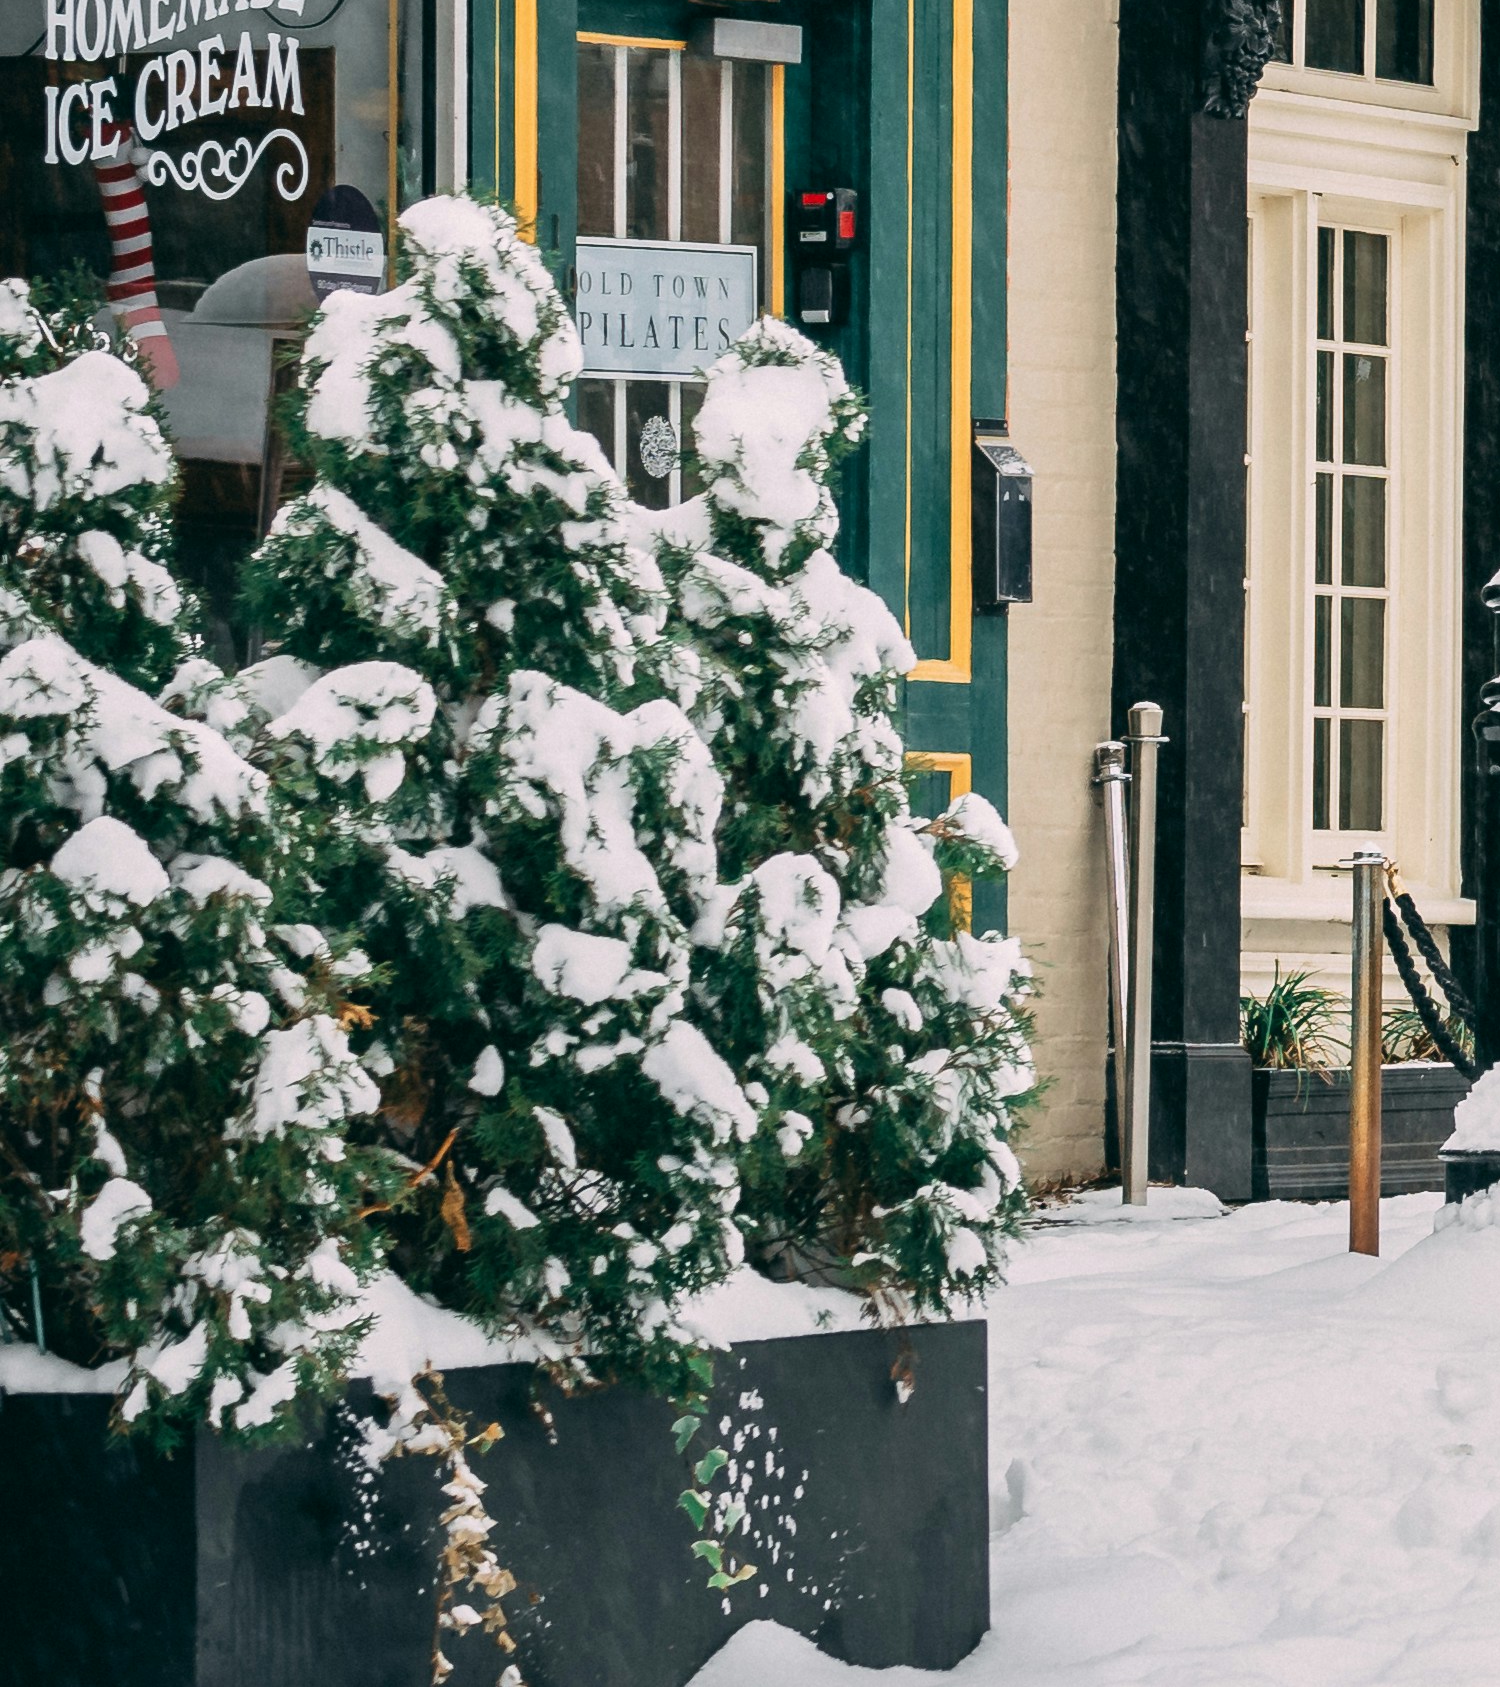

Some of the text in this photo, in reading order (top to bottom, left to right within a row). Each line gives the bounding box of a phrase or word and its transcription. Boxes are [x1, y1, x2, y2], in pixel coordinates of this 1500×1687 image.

[43, 30, 306, 166] ICE CREAM
[323, 236, 375, 261] Thistle
[579, 270, 732, 301] OLD TOWN
[579, 313, 732, 352] PILATES
